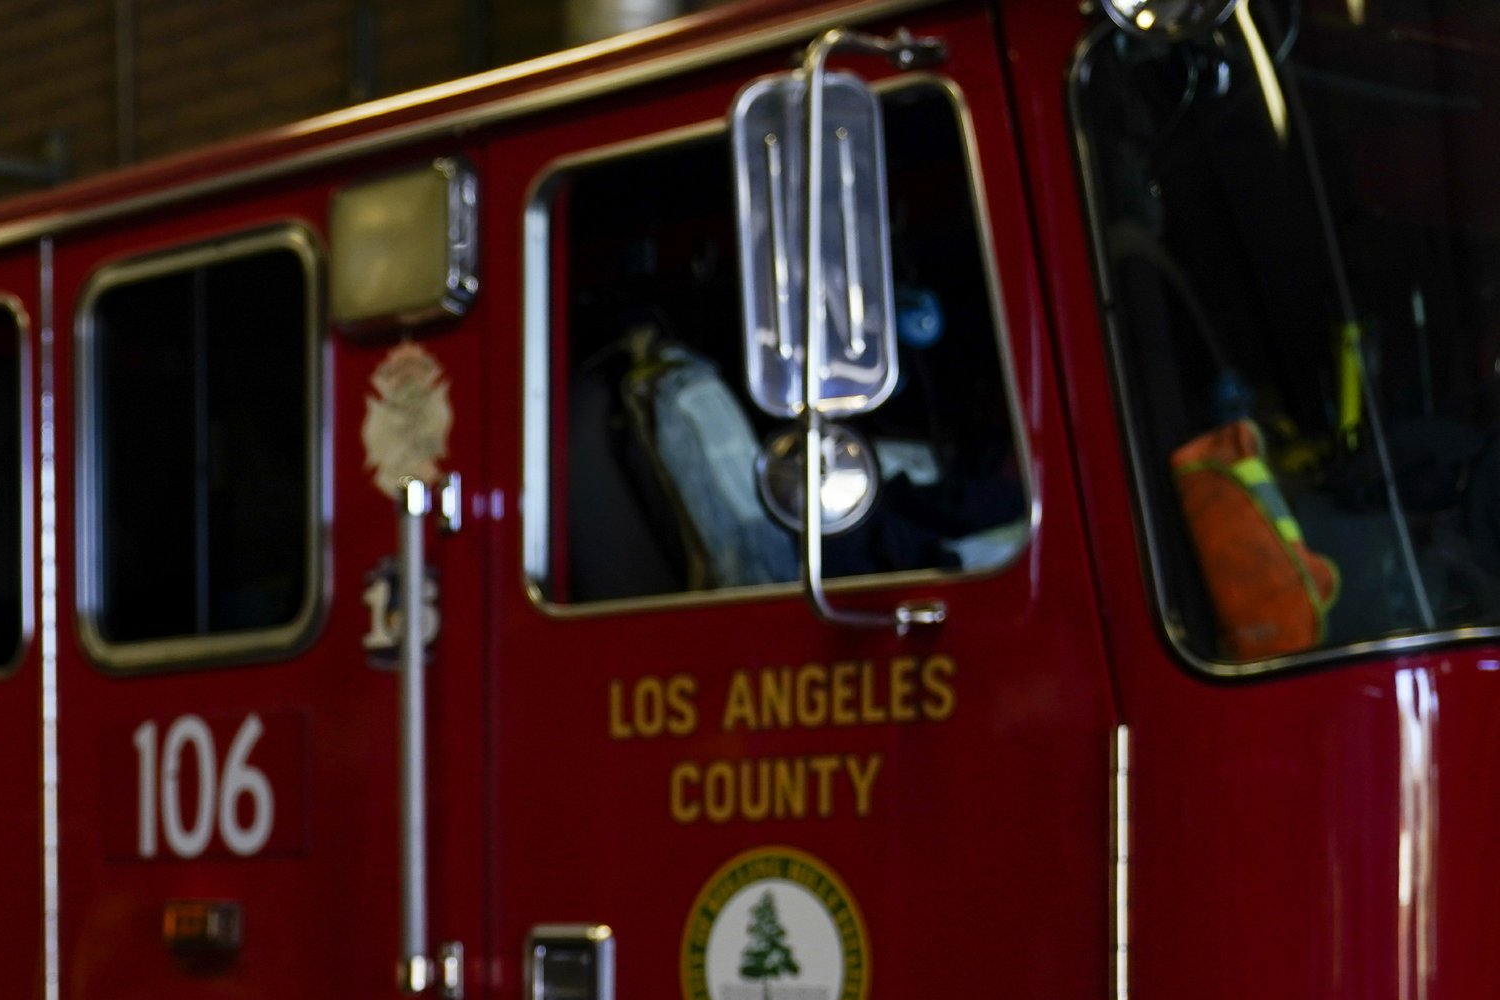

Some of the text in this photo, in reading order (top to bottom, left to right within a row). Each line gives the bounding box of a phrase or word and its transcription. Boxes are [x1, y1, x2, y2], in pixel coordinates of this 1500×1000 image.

[609, 654, 957, 739] LOS ANGELES
[133, 713, 274, 858] 106
[670, 753, 882, 823] COUNTY
